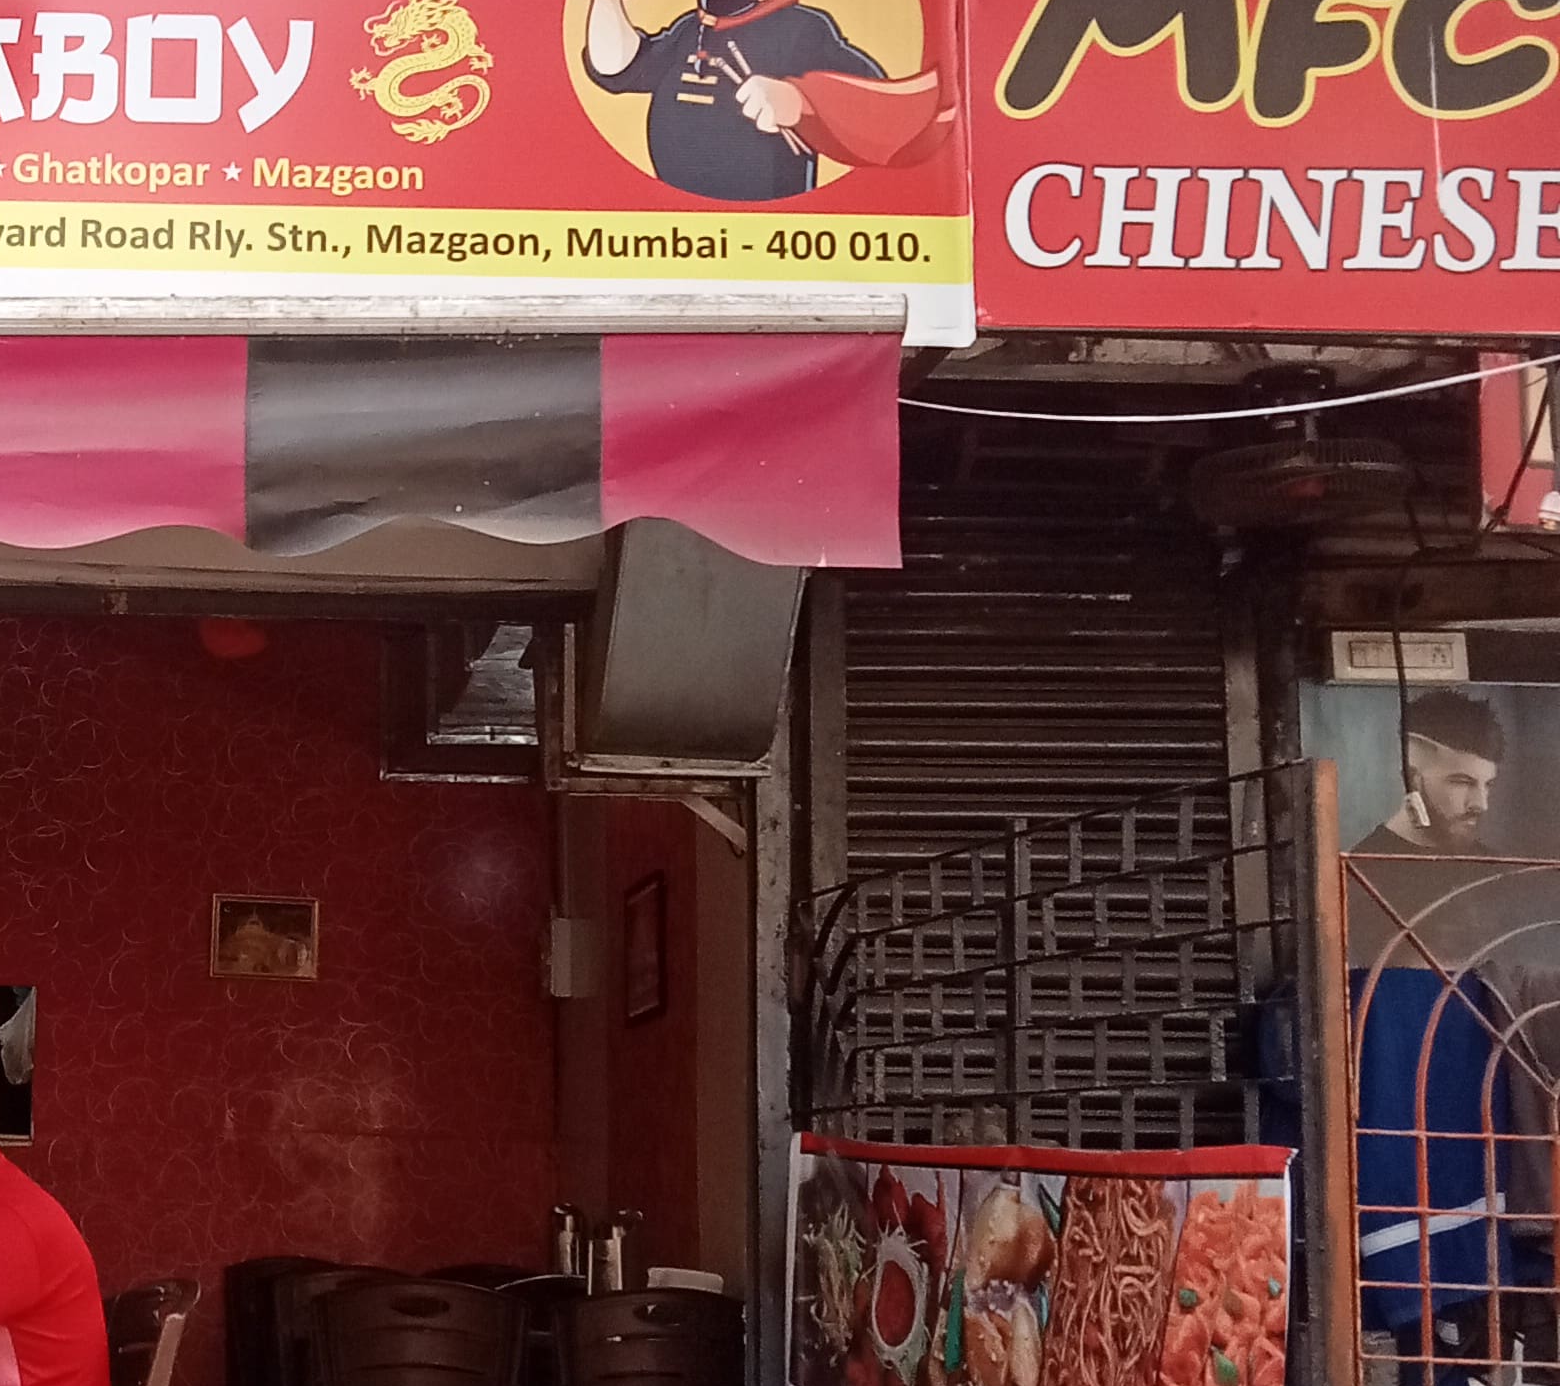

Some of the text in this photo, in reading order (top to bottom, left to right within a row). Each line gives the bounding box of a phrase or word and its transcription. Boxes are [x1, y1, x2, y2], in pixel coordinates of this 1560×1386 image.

[12, 150, 211, 193] Ghatkopar
[252, 156, 424, 197] Mazgaon
[80, 217, 175, 251] Road
[189, 219, 254, 259] Rly.
[267, 222, 352, 259] Stn.,
[366, 224, 553, 264] Mazgaon,
[567, 226, 729, 260] Mumbai
[766, 230, 838, 261] 400
[849, 231, 932, 263] 010.
[1004, 162, 1560, 273] CHINESE
